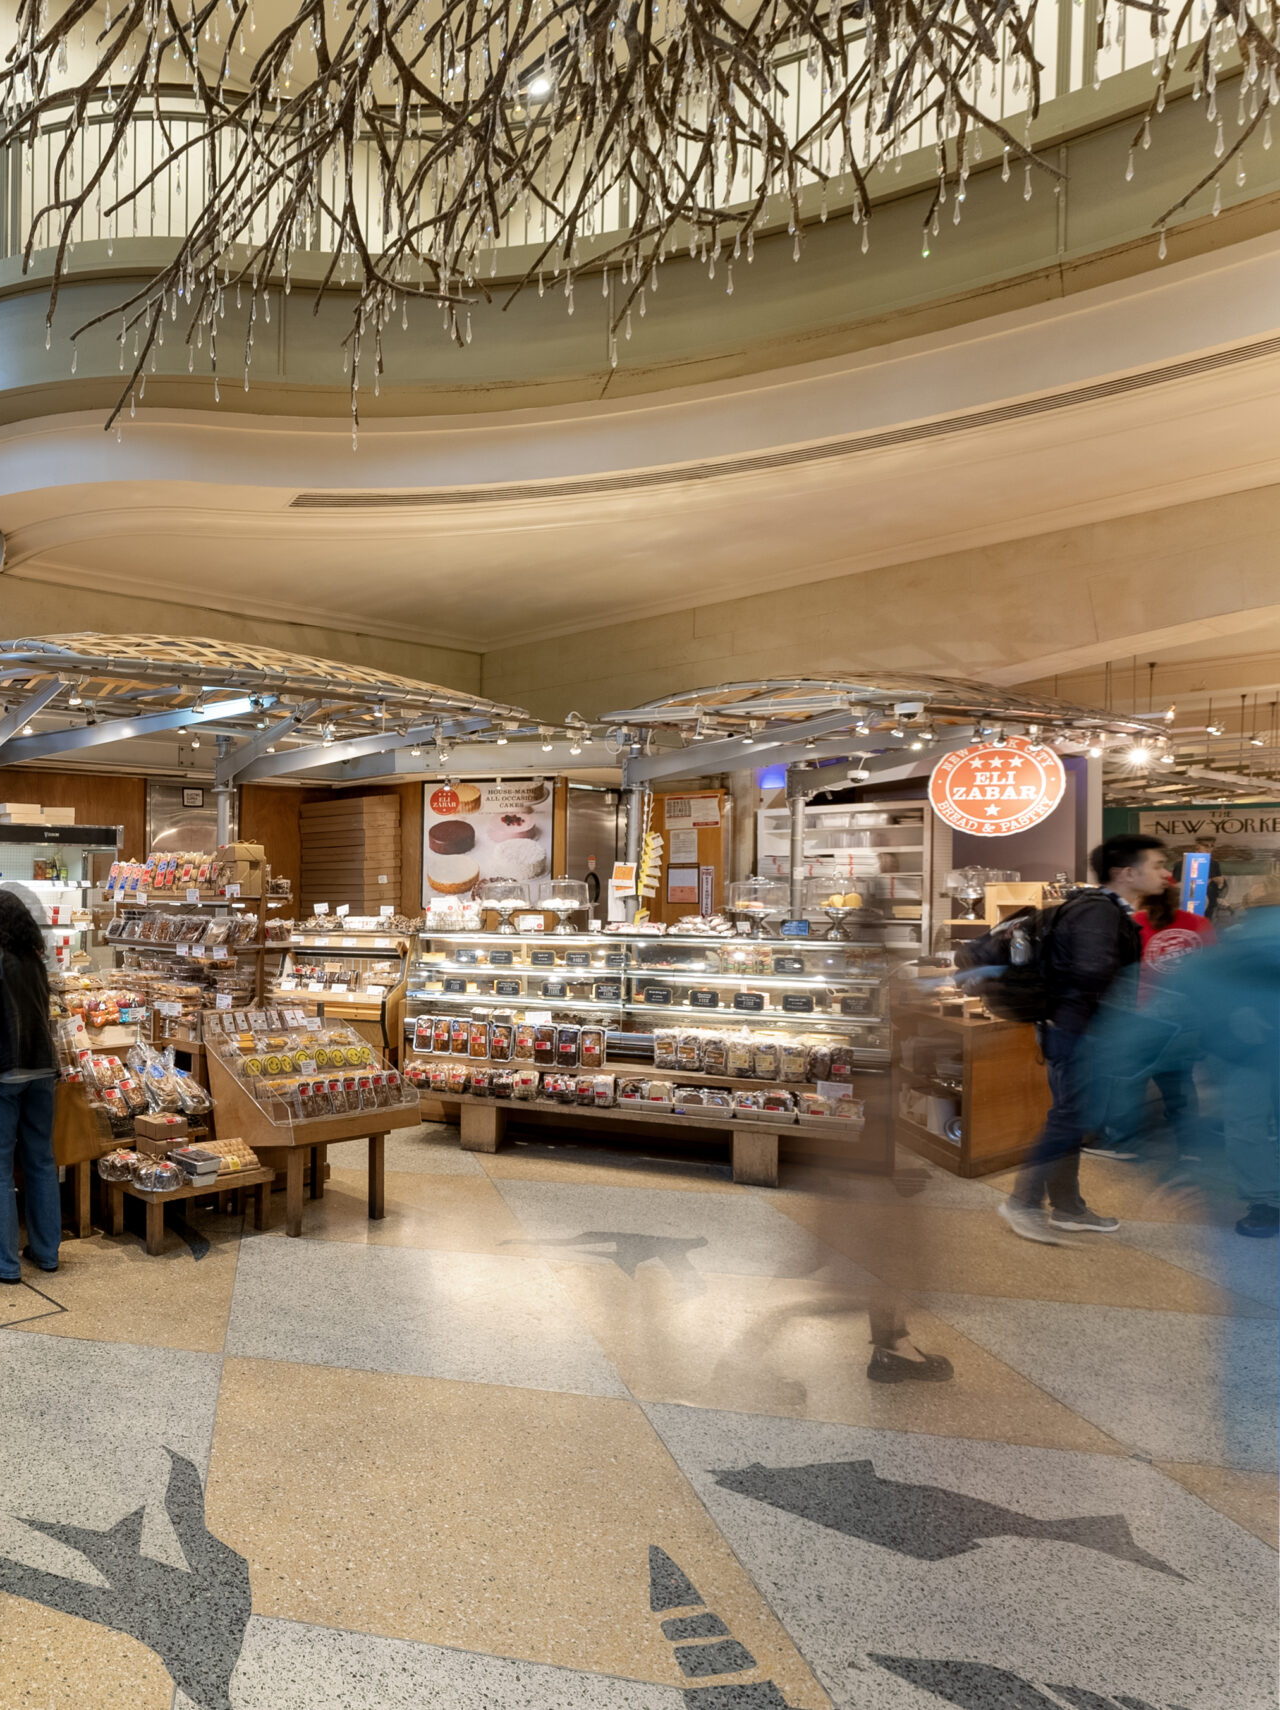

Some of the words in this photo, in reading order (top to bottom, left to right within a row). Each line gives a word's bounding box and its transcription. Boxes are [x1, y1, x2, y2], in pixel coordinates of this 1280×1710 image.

[942, 749, 969, 771] NEW
[973, 771, 1016, 785] ELI
[952, 785, 1038, 800] ZABAR
[937, 800, 978, 830] BREAD
[982, 823, 996, 832] &
[999, 796, 1054, 831] PASTRY
[1153, 819, 1207, 835] NEW
